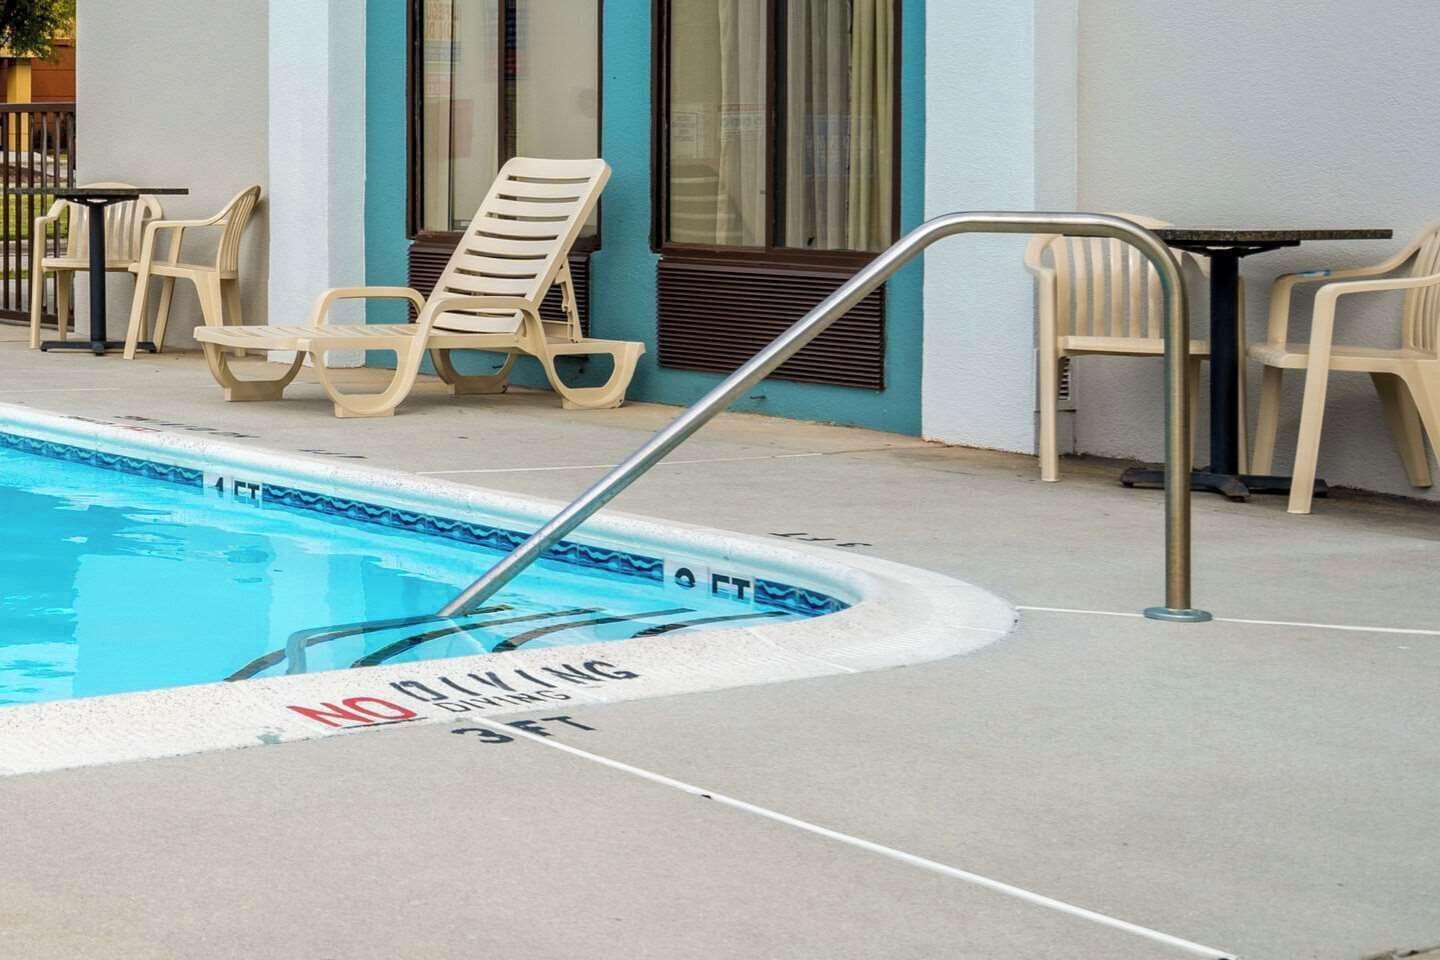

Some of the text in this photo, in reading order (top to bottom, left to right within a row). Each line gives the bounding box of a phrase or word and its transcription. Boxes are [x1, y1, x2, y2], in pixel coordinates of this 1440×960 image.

[286, 660, 640, 728] NO DIVING
[432, 690, 572, 714] DIVING
[450, 727, 515, 744] 3
